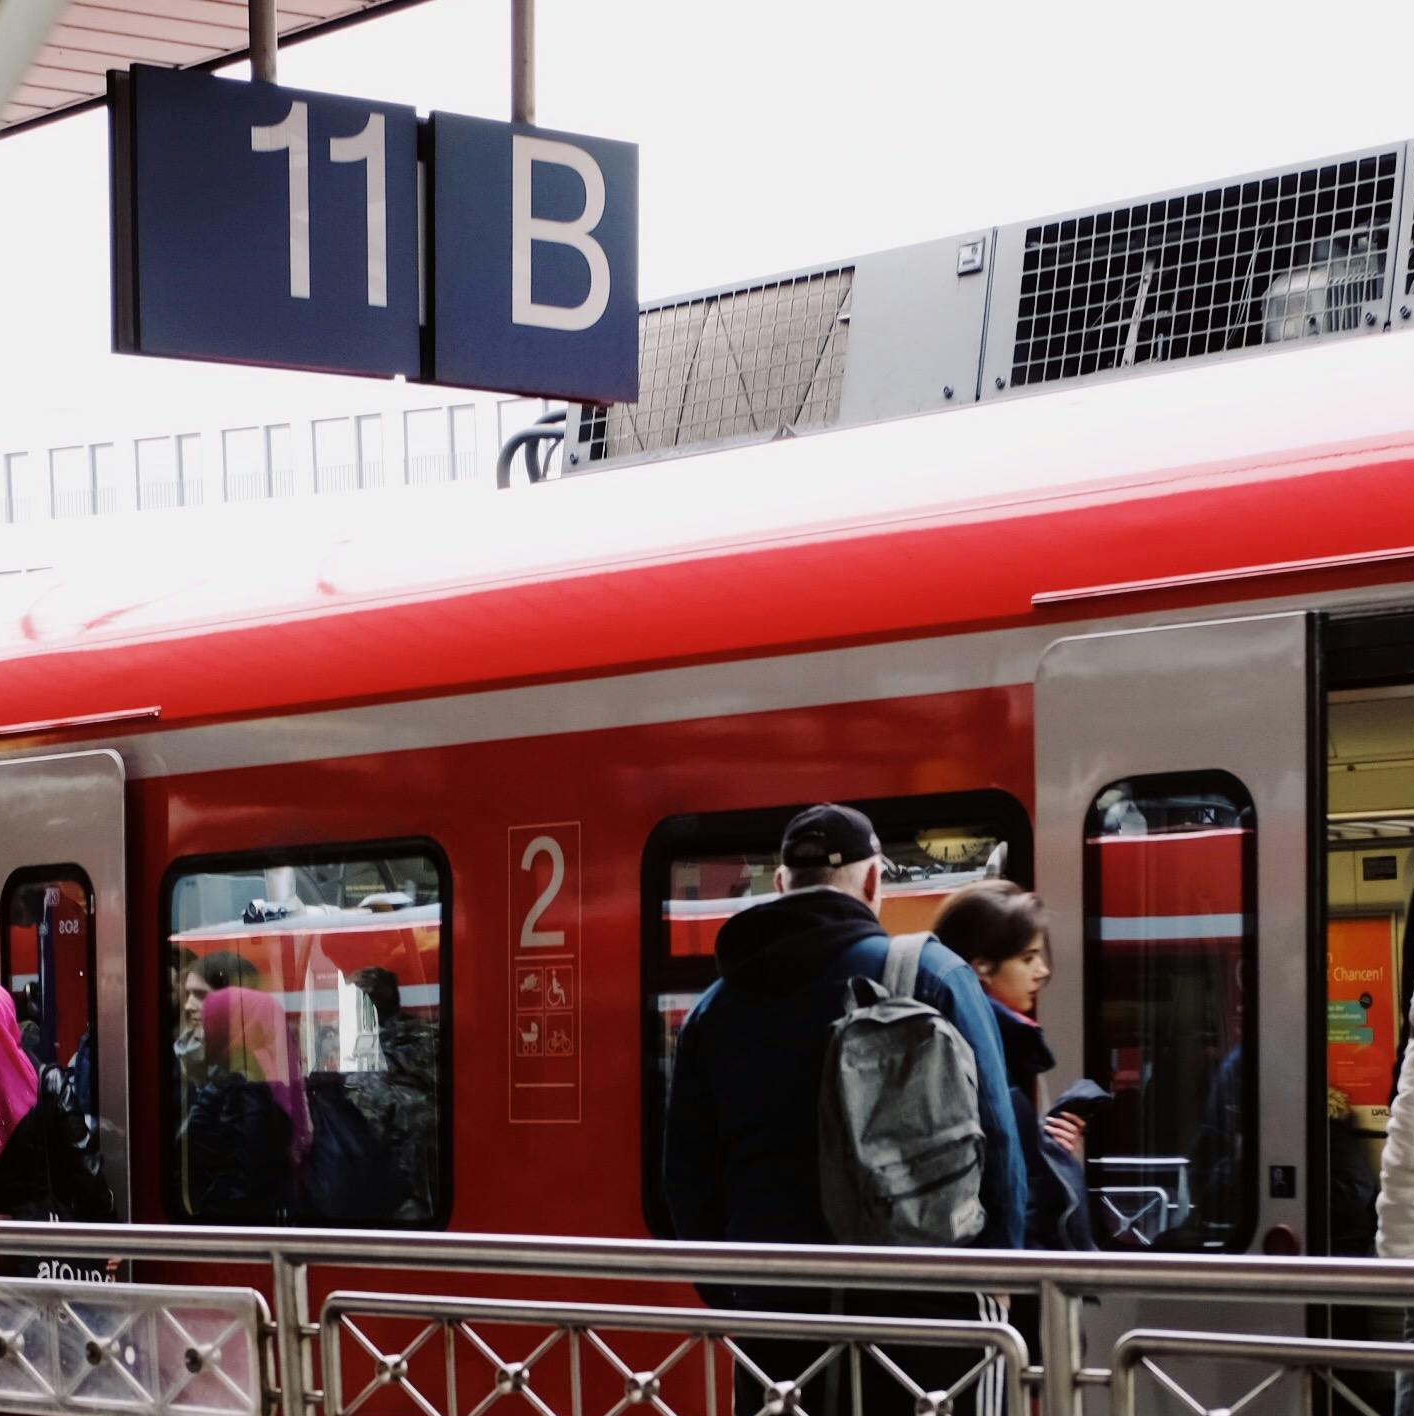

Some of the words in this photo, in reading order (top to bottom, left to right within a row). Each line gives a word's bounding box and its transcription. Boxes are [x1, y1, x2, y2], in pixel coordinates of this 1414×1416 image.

[251, 101, 388, 308] 11
[511, 134, 612, 332] B
[520, 835, 566, 948] 2
[1333, 967, 1384, 982] Chancen!
